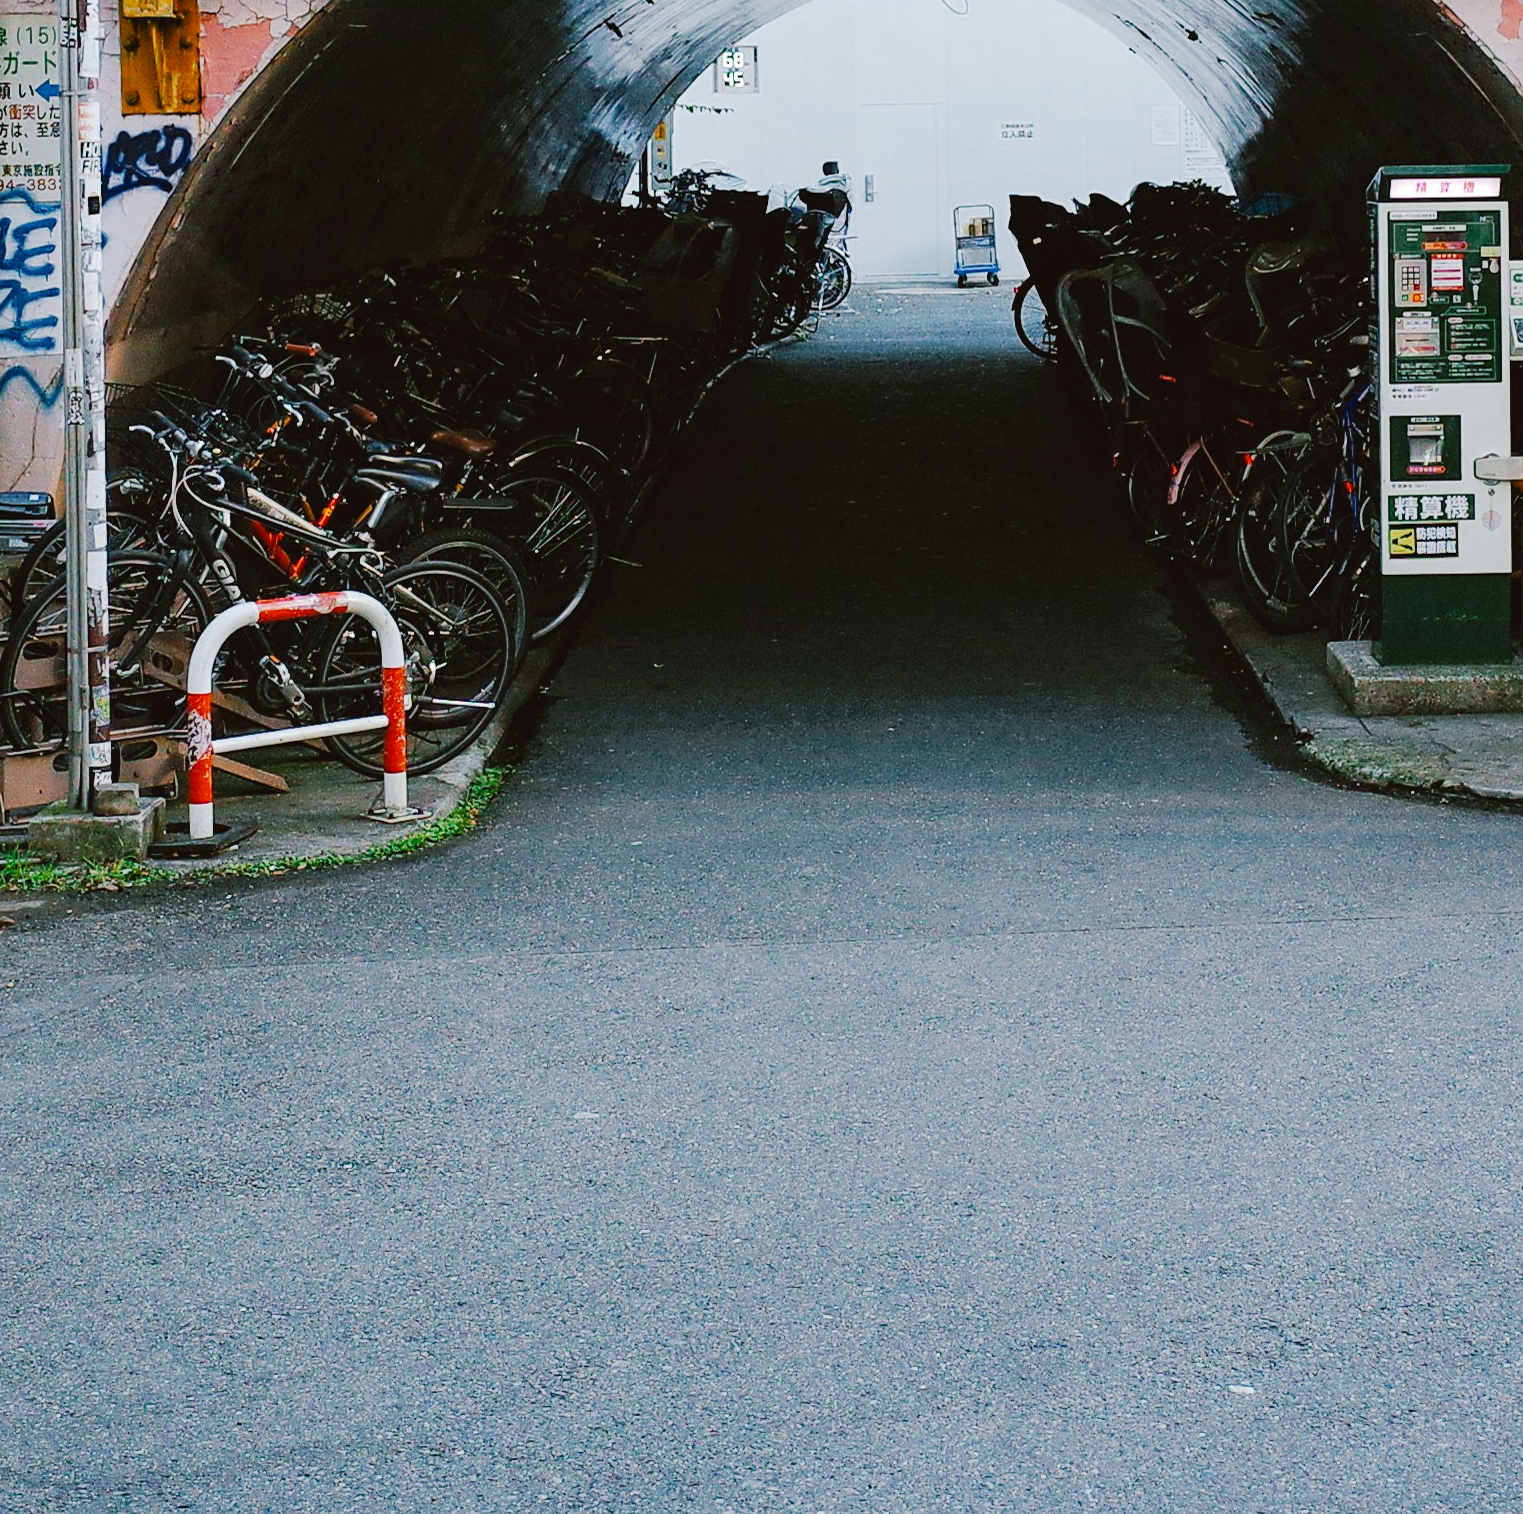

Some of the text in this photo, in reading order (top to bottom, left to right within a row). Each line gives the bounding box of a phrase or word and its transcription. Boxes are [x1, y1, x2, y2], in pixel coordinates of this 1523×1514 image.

[722, 51, 744, 68] 68
[723, 71, 745, 88] 45
[1415, 181, 1476, 195] 精算機
[1394, 495, 1470, 521] 精算機
